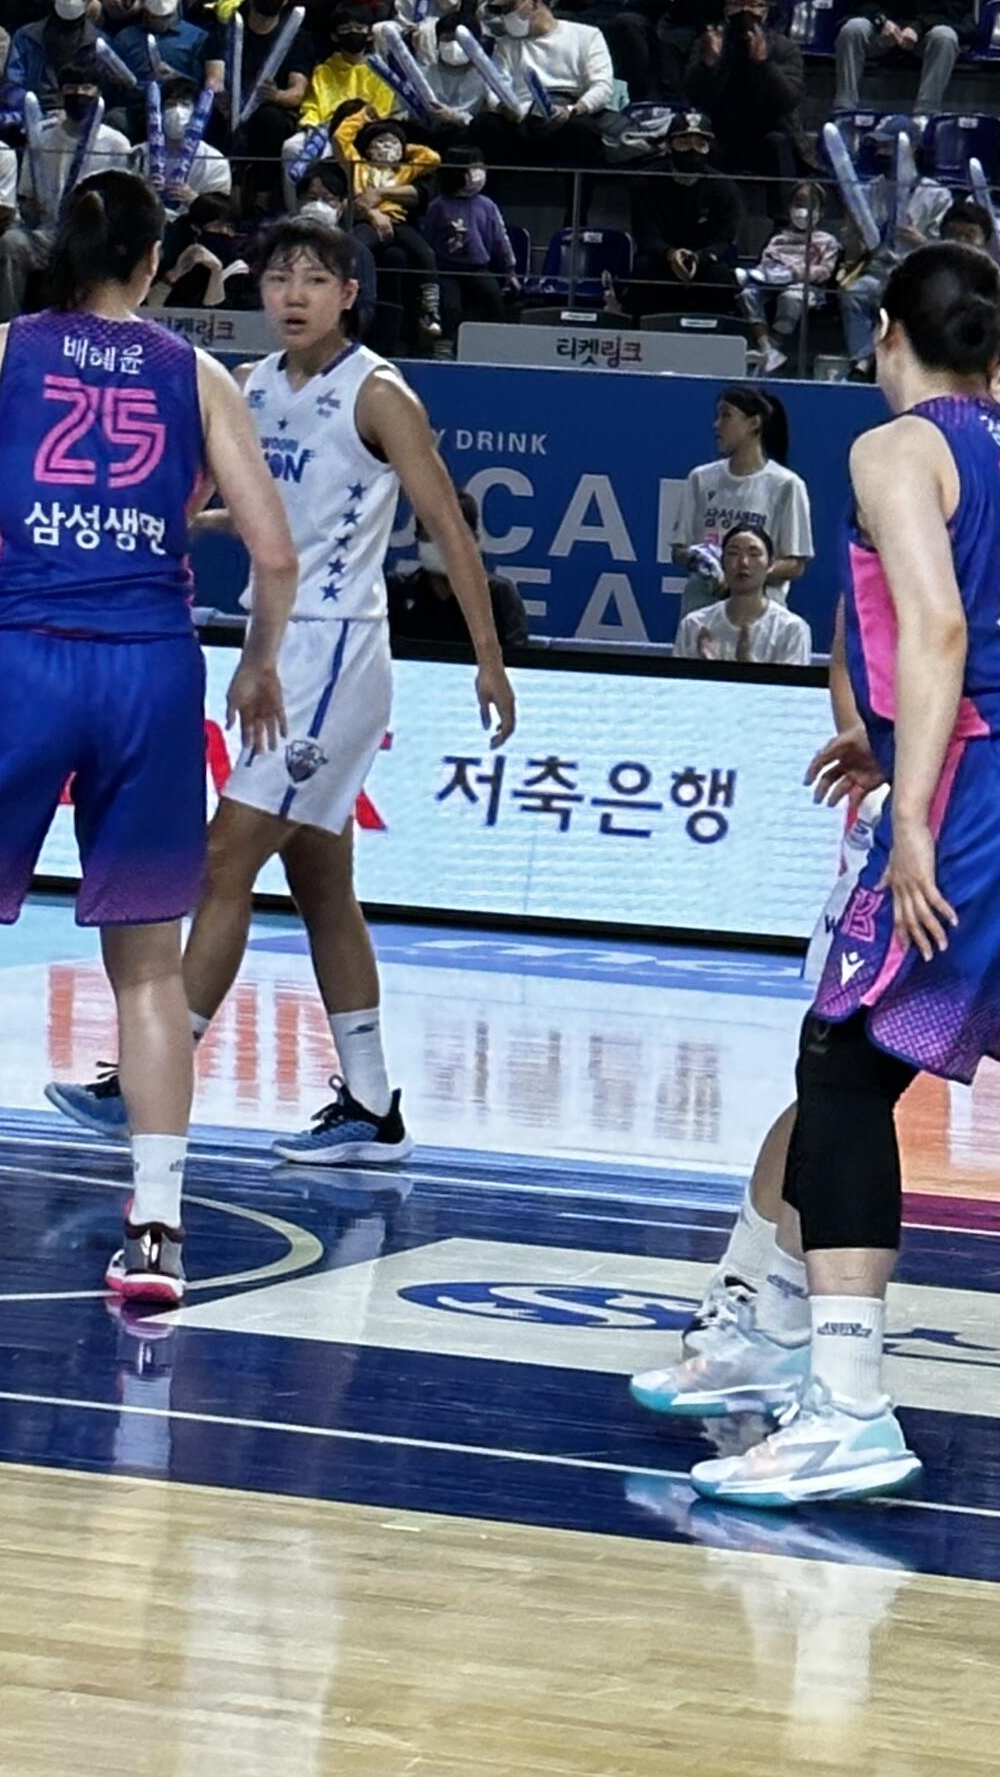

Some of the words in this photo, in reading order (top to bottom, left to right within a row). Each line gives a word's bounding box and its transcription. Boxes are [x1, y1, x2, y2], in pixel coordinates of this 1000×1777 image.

[63, 335, 144, 375] 배혜윤
[556, 335, 643, 369] 티켓링크
[34, 374, 166, 489] 25
[456, 428, 548, 455] DRINK
[435, 754, 738, 845] 저축은행
